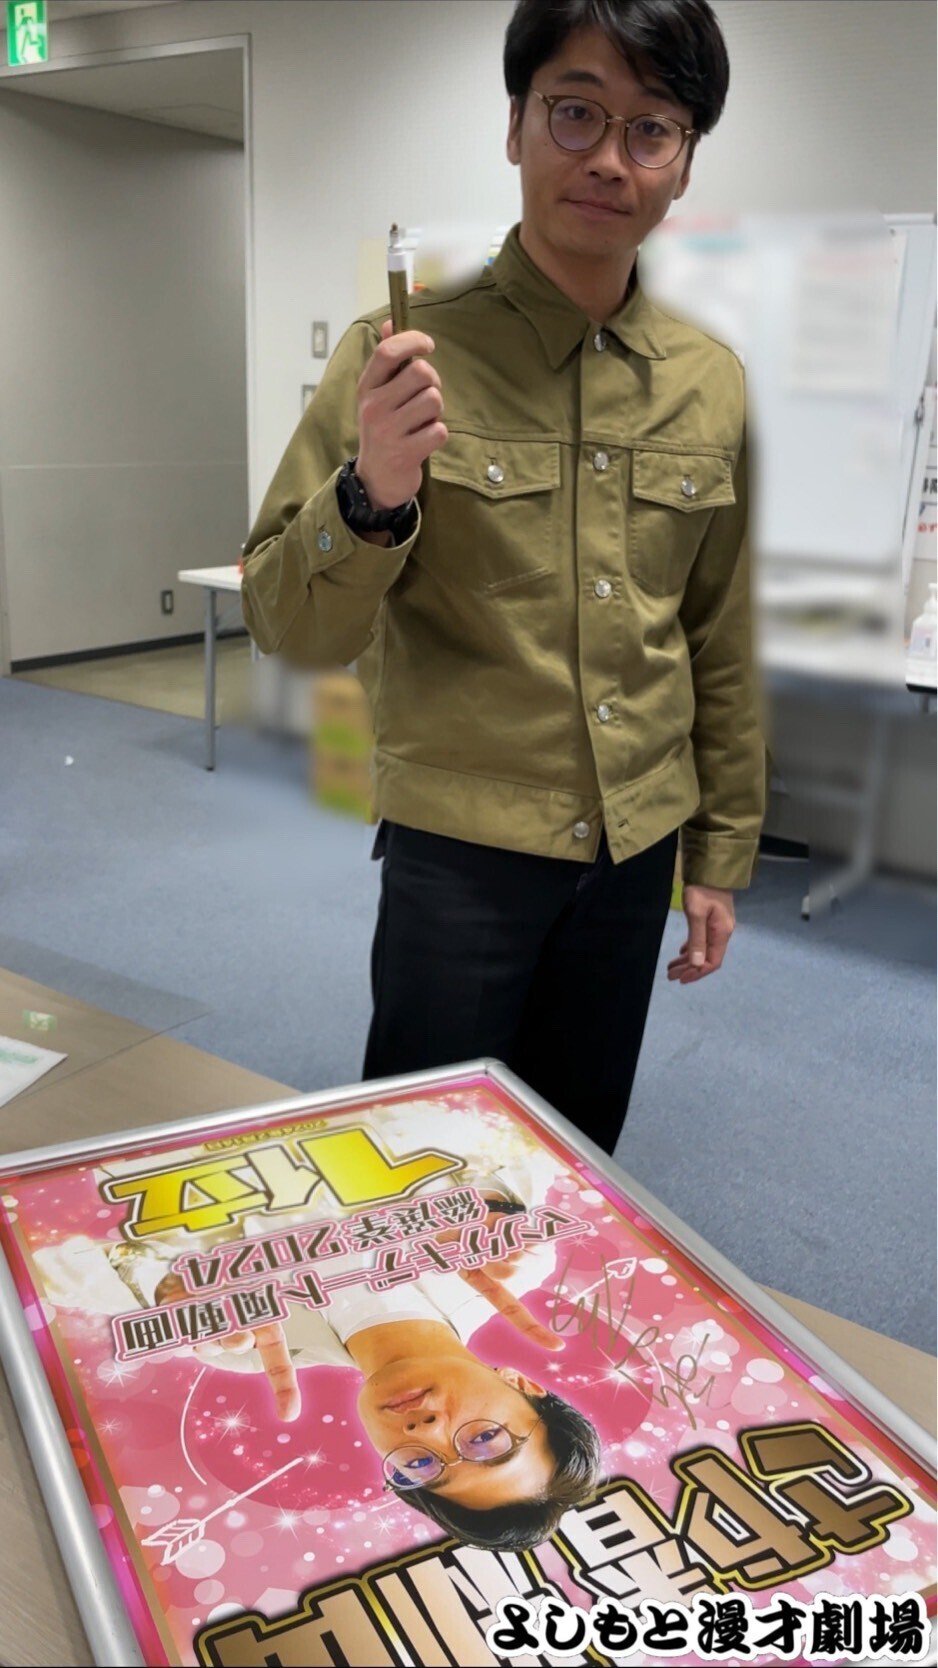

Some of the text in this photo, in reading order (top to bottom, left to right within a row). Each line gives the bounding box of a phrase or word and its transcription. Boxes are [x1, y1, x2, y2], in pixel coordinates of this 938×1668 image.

[108, 1126, 465, 1240] 1位
[119, 1205, 588, 1356] マンゲキデート風動画
